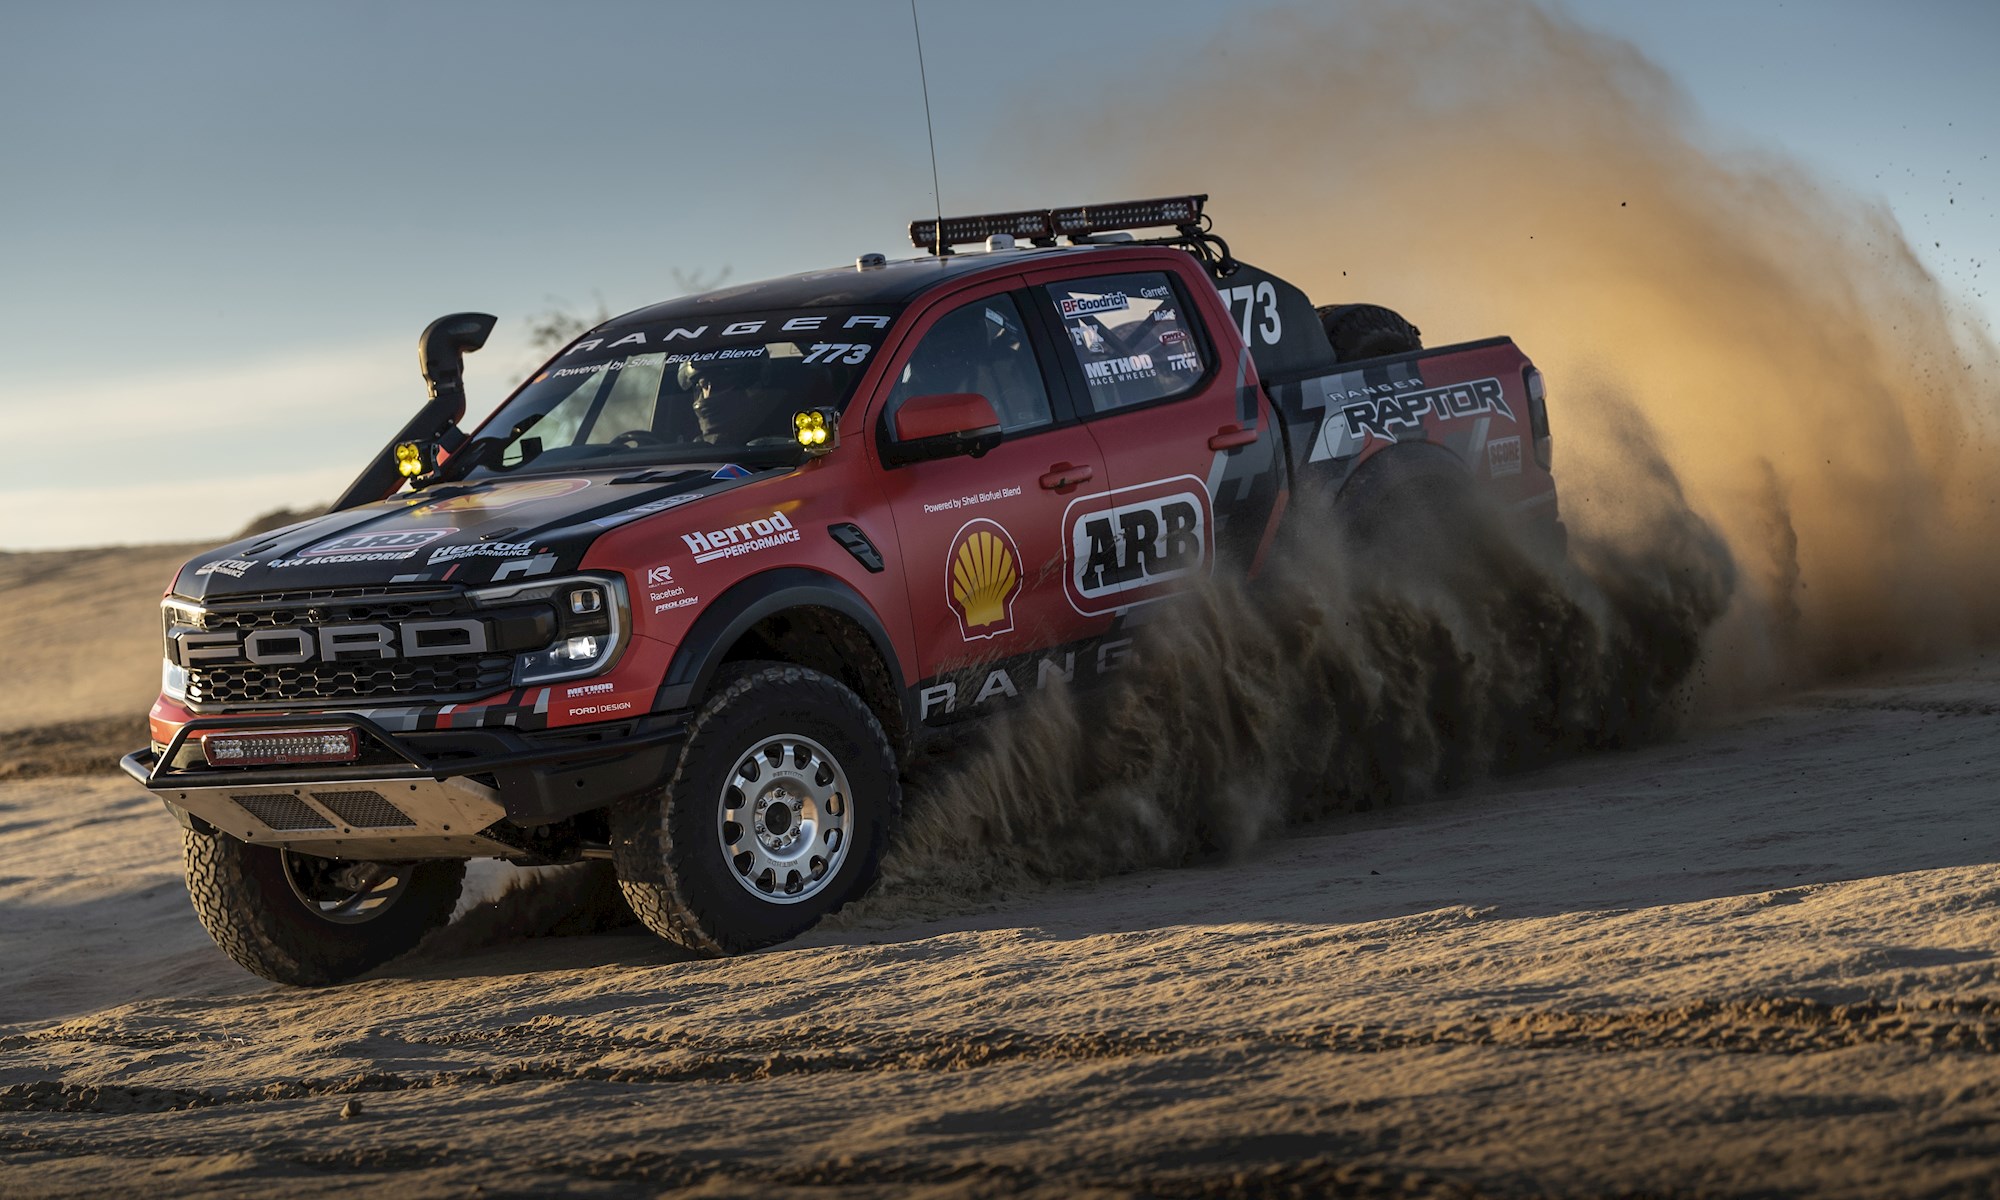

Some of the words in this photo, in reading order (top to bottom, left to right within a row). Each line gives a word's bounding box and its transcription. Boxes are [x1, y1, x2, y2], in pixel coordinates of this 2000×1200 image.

[1140, 286, 1169, 298] Garrett
[1062, 294, 1127, 313] BFGoodrich
[565, 315, 892, 356] RANGER
[553, 360, 610, 379] Powered
[610, 360, 628, 372] by
[666, 350, 718, 364] Biofuel
[719, 347, 765, 360] Blend
[802, 343, 872, 365] 773
[1084, 354, 1153, 379] METHOD
[1090, 376, 1115, 387] RACE
[1118, 369, 1157, 382] WHEELS
[1329, 378, 1424, 401] RANGER
[1340, 377, 1517, 444] RAPTOR
[924, 499, 952, 513] Powered
[953, 499, 962, 508] by
[962, 494, 979, 506] Shell
[979, 489, 1002, 503] Biofuel
[1002, 485, 1022, 498] Blend
[329, 533, 430, 551] ARB
[680, 510, 793, 554] Herrod
[430, 540, 537, 559] Herrod
[452, 549, 531, 560] PERFORMANCE
[724, 529, 800, 559] PERFORMANCE
[1082, 501, 1200, 591] ARB
[648, 565, 673, 585] KR
[650, 586, 685, 602] Racetech
[177, 618, 487, 668] FORD
[567, 682, 614, 696] METHOD
[569, 706, 597, 716] FORD
[600, 701, 631, 712] DESIGN
